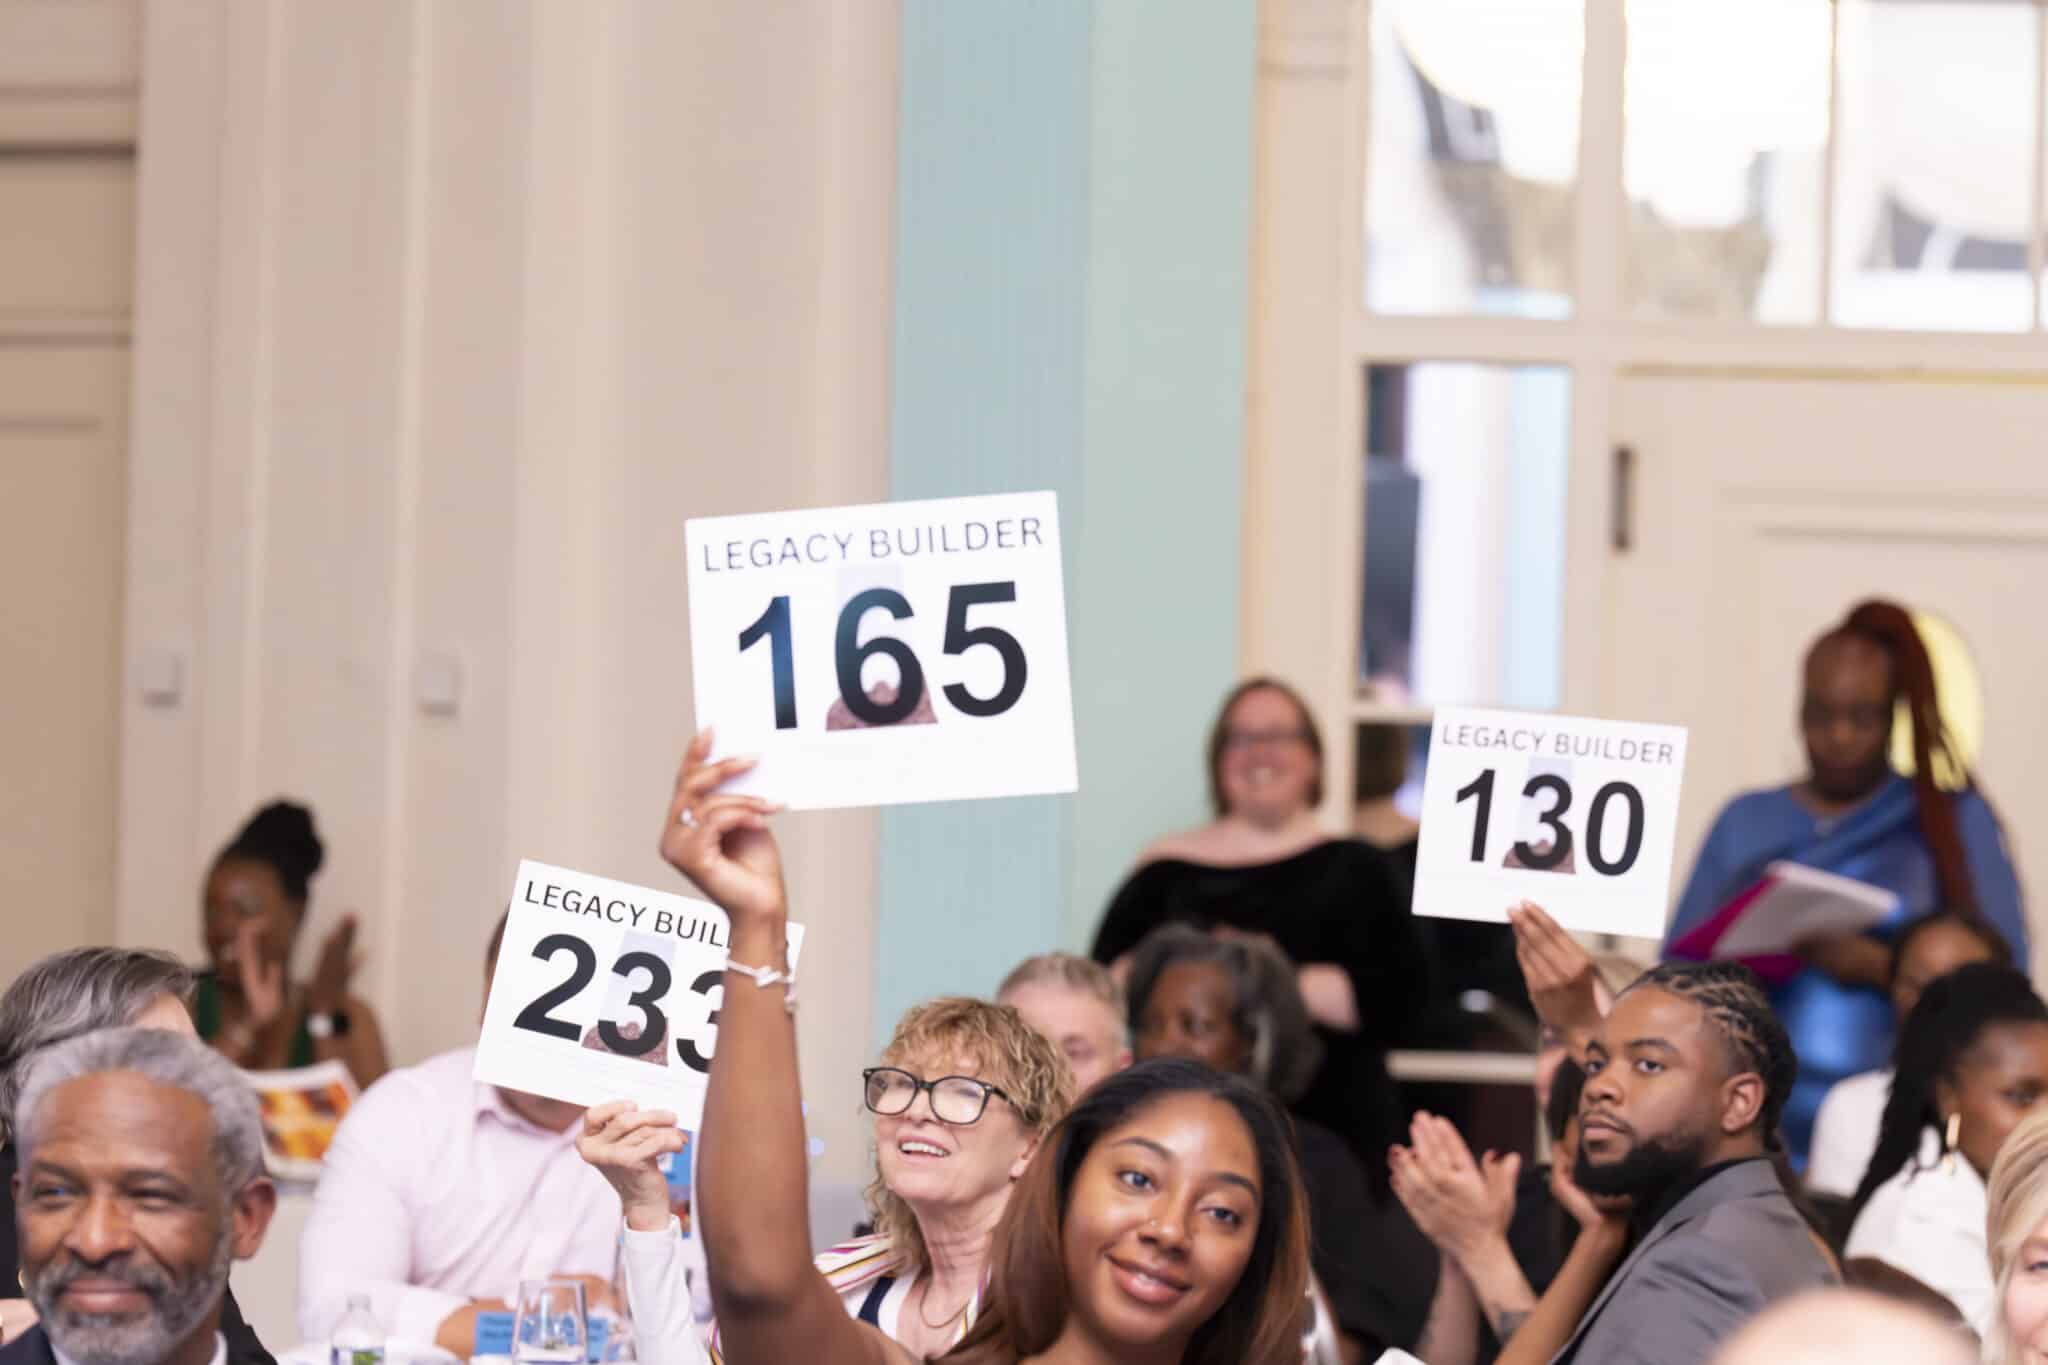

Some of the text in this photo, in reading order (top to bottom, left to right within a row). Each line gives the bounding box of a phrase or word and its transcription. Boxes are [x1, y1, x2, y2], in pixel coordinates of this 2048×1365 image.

[703, 517, 1044, 573] LEGACY BUILDER
[738, 580, 1028, 731] 165
[1442, 724, 1673, 765] LEGACY BUILDER
[1456, 769, 1645, 876] 130
[524, 880, 727, 948] LEGACY BUIL
